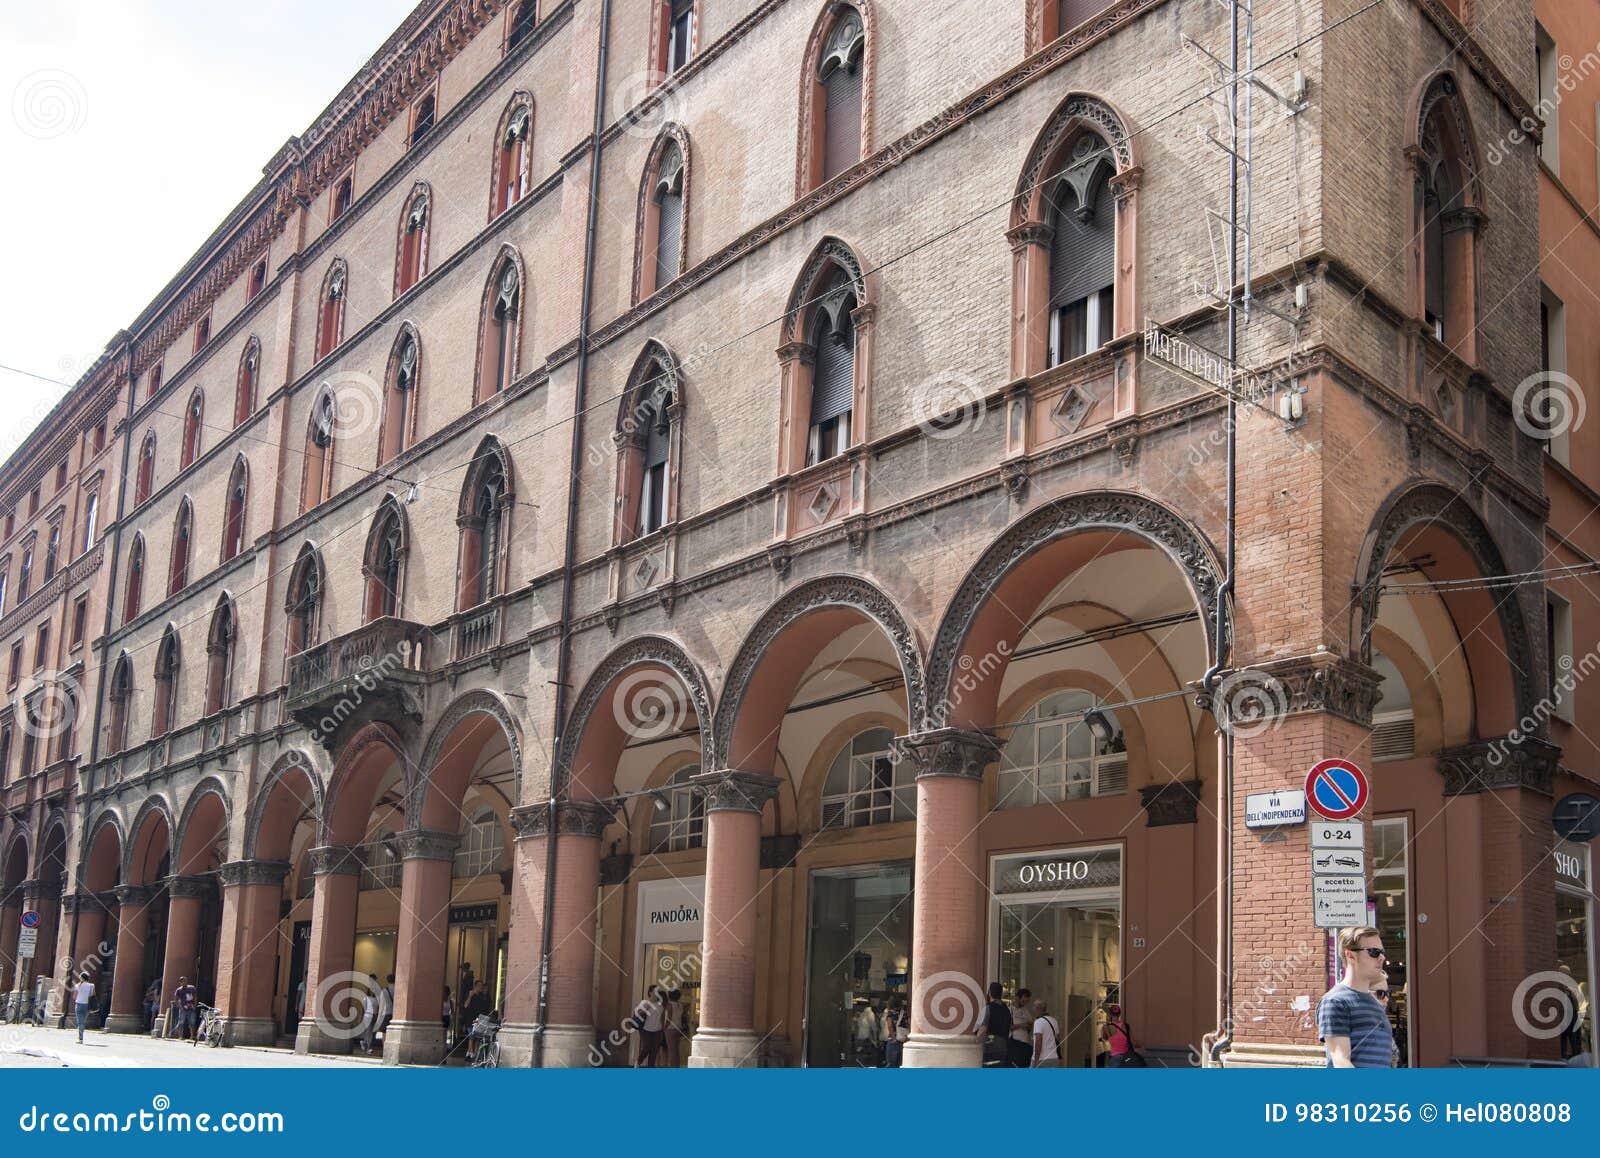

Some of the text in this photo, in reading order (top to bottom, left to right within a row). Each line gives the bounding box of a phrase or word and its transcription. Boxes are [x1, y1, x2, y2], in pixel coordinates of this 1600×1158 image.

[1269, 798, 1281, 807] VIA
[1246, 808, 1305, 822] DELL'INDIPENDENZA
[1323, 829, 1352, 840] 0-24
[1019, 860, 1089, 884] OYSHO
[1553, 850, 1580, 879] SHO
[651, 906, 699, 924] PANDORA
